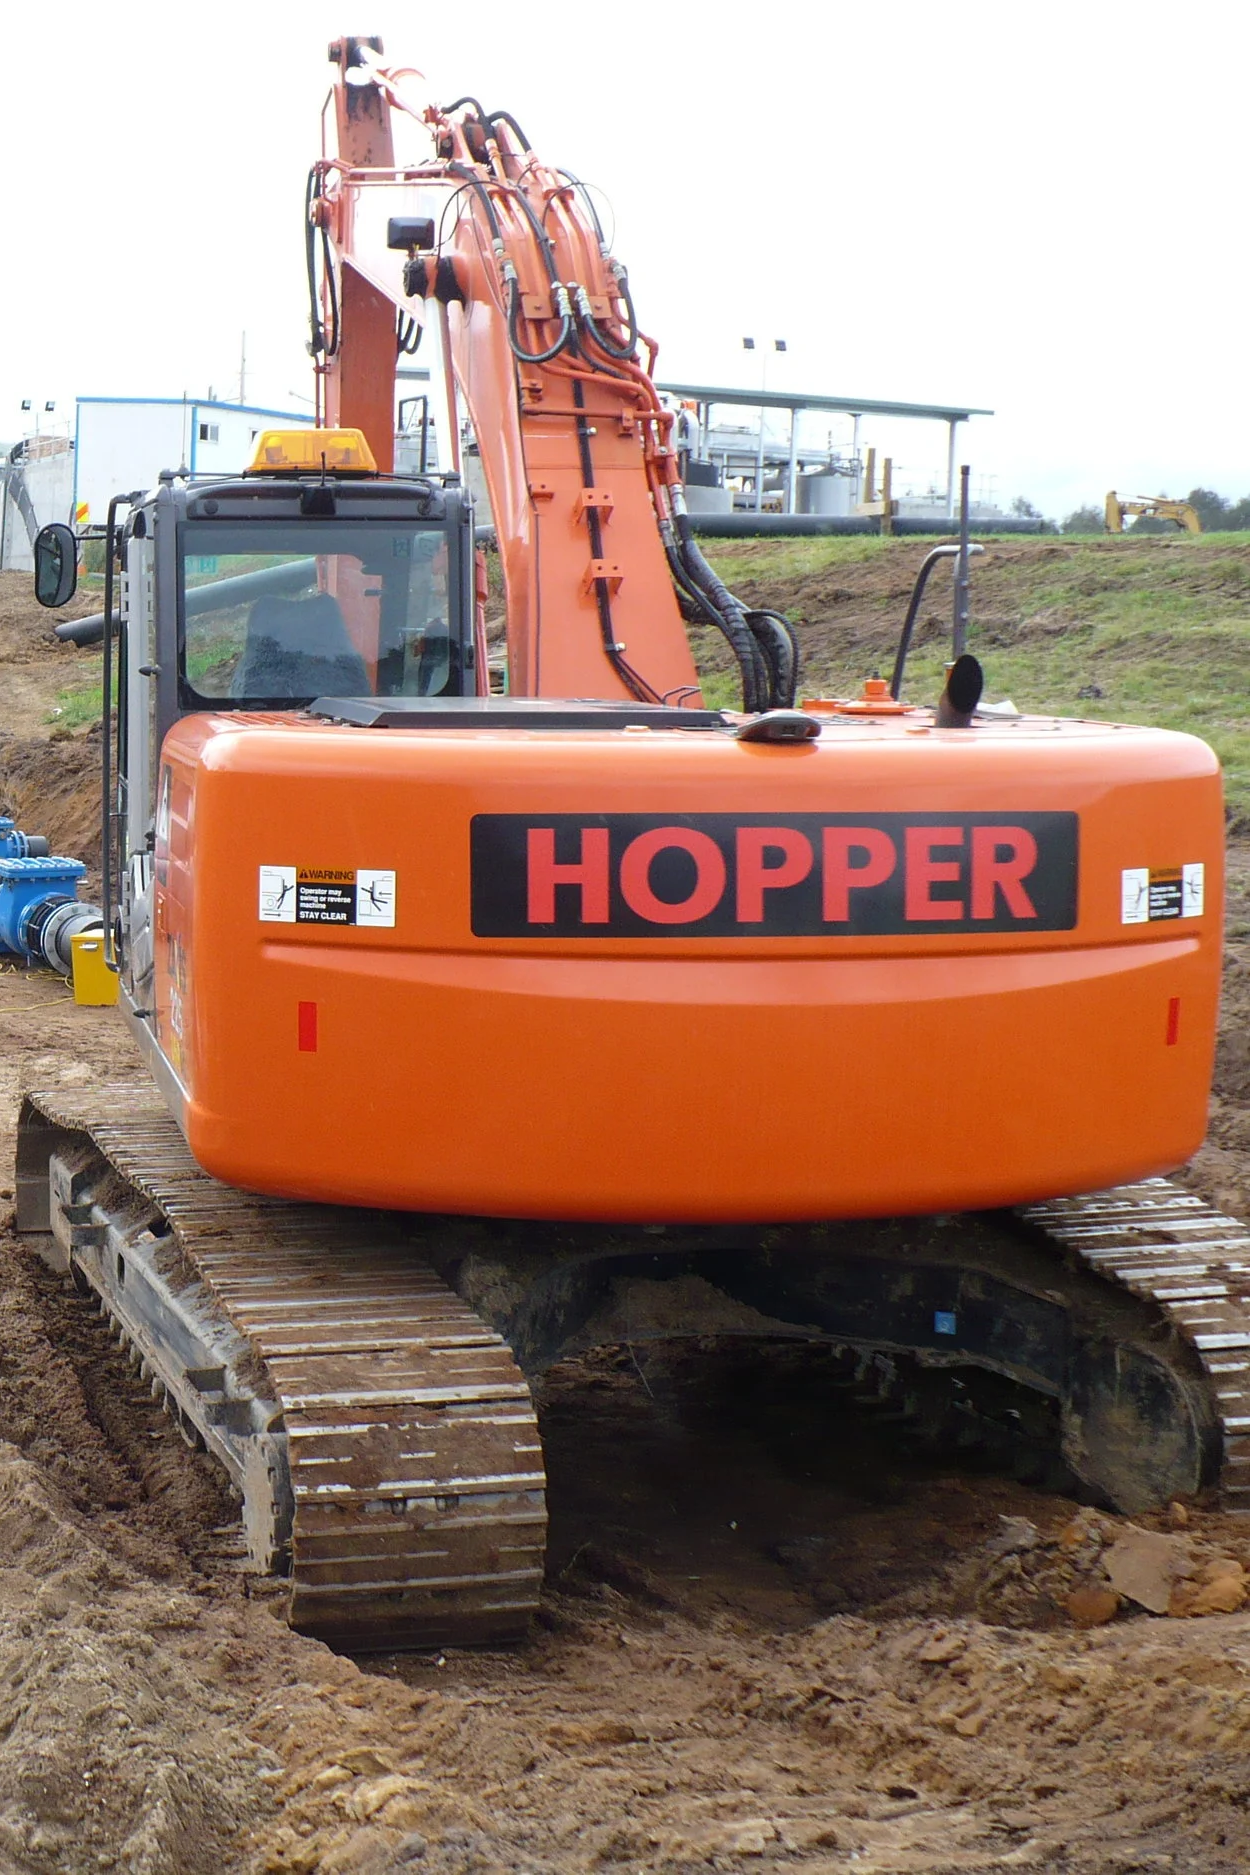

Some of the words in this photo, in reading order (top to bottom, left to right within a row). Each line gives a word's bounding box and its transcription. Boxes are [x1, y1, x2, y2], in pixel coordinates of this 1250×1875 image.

[309, 869, 355, 880] WARNING
[527, 826, 1038, 924] HOPPER
[300, 887, 327, 895] Operator
[300, 911, 320, 919] STAY
[320, 911, 347, 920] CLEAR
